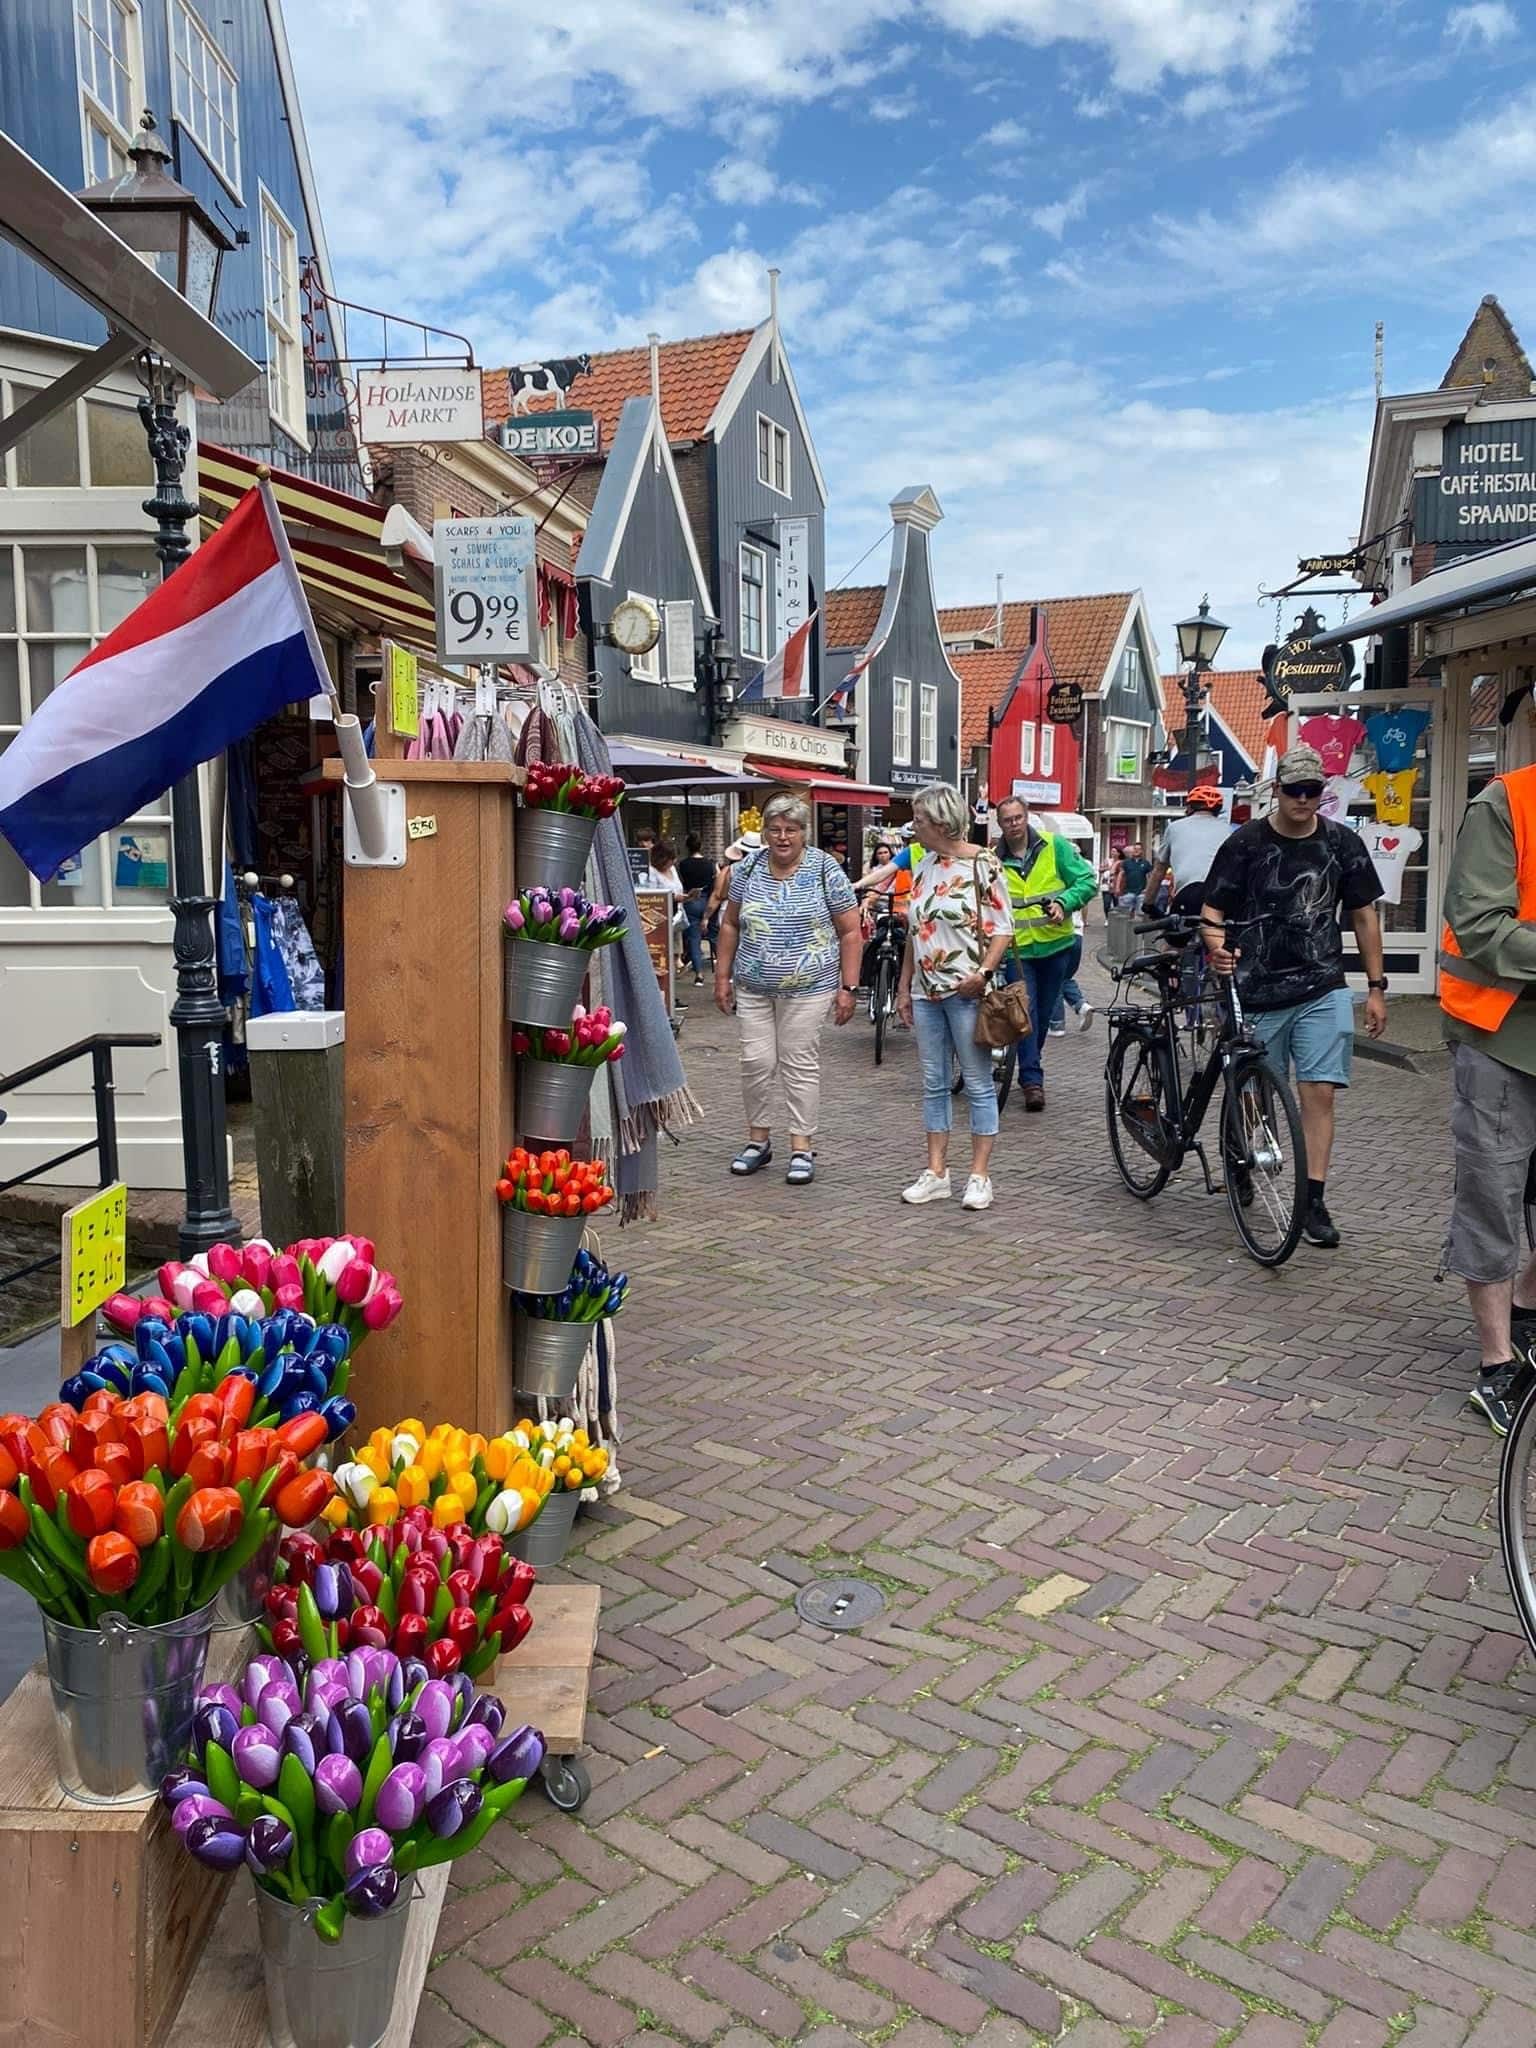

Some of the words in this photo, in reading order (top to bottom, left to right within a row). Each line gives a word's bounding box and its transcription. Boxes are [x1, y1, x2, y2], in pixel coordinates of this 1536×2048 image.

[367, 382, 475, 406] HOLLANDSE
[386, 408, 457, 428] MARKT
[505, 428, 537, 450] DE
[547, 424, 595, 448] KOE
[1460, 442, 1524, 464] HOTEL
[446, 526, 479, 537] SCARFS
[486, 526, 493, 536] 4
[499, 525, 521, 536] YOU
[451, 558, 480, 569] SCHALS
[485, 558, 491, 569] &
[495, 557, 518, 569] LOOPS
[1305, 559, 1332, 571] ANNO
[505, 620, 520, 640] €
[1275, 660, 1343, 678] Restaurant
[765, 729, 787, 748] Fish
[790, 737, 798, 750] &
[800, 736, 828, 757] Chips
